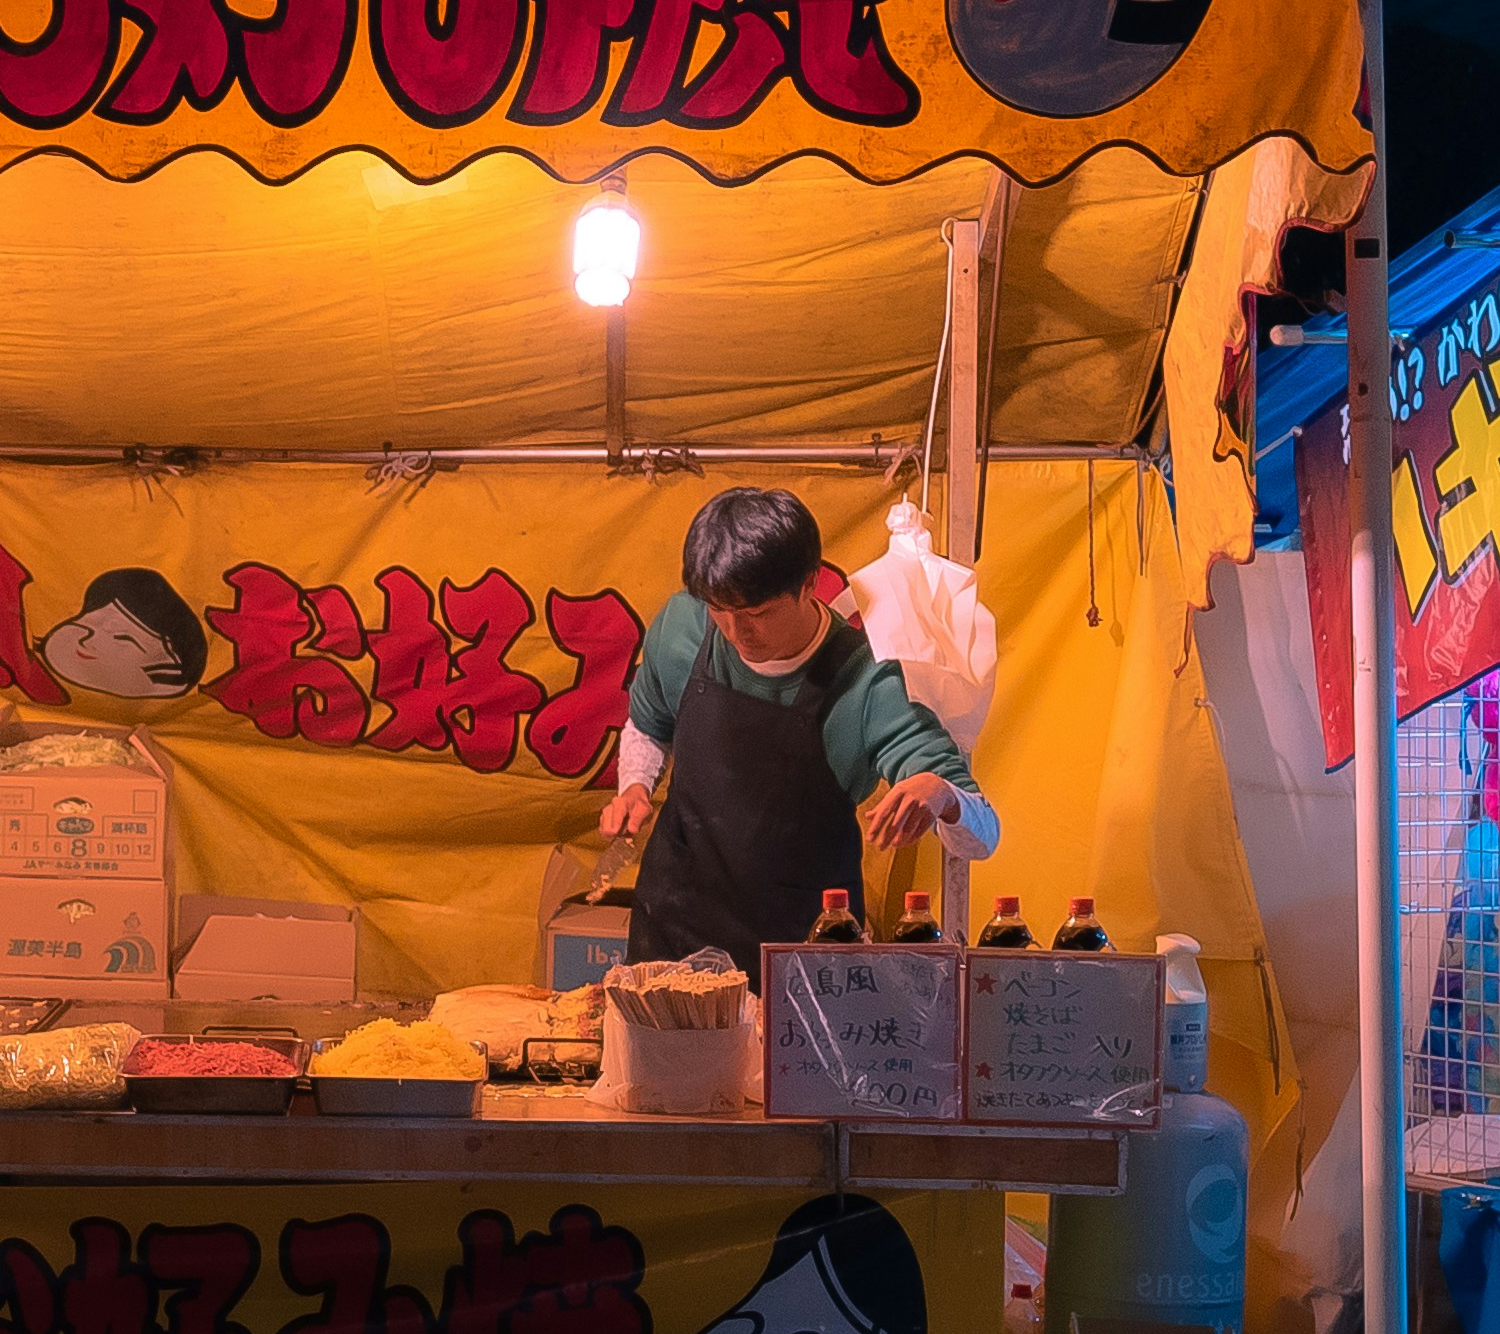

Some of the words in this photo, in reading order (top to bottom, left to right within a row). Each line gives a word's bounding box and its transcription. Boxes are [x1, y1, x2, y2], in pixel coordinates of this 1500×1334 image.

[71, 838, 87, 857] 8
[1004, 970, 1083, 999] ベーコン
[1003, 1002, 1084, 1027] 焼そば
[1006, 1031, 1076, 1055] たまご
[1088, 1034, 1133, 1058] 入り
